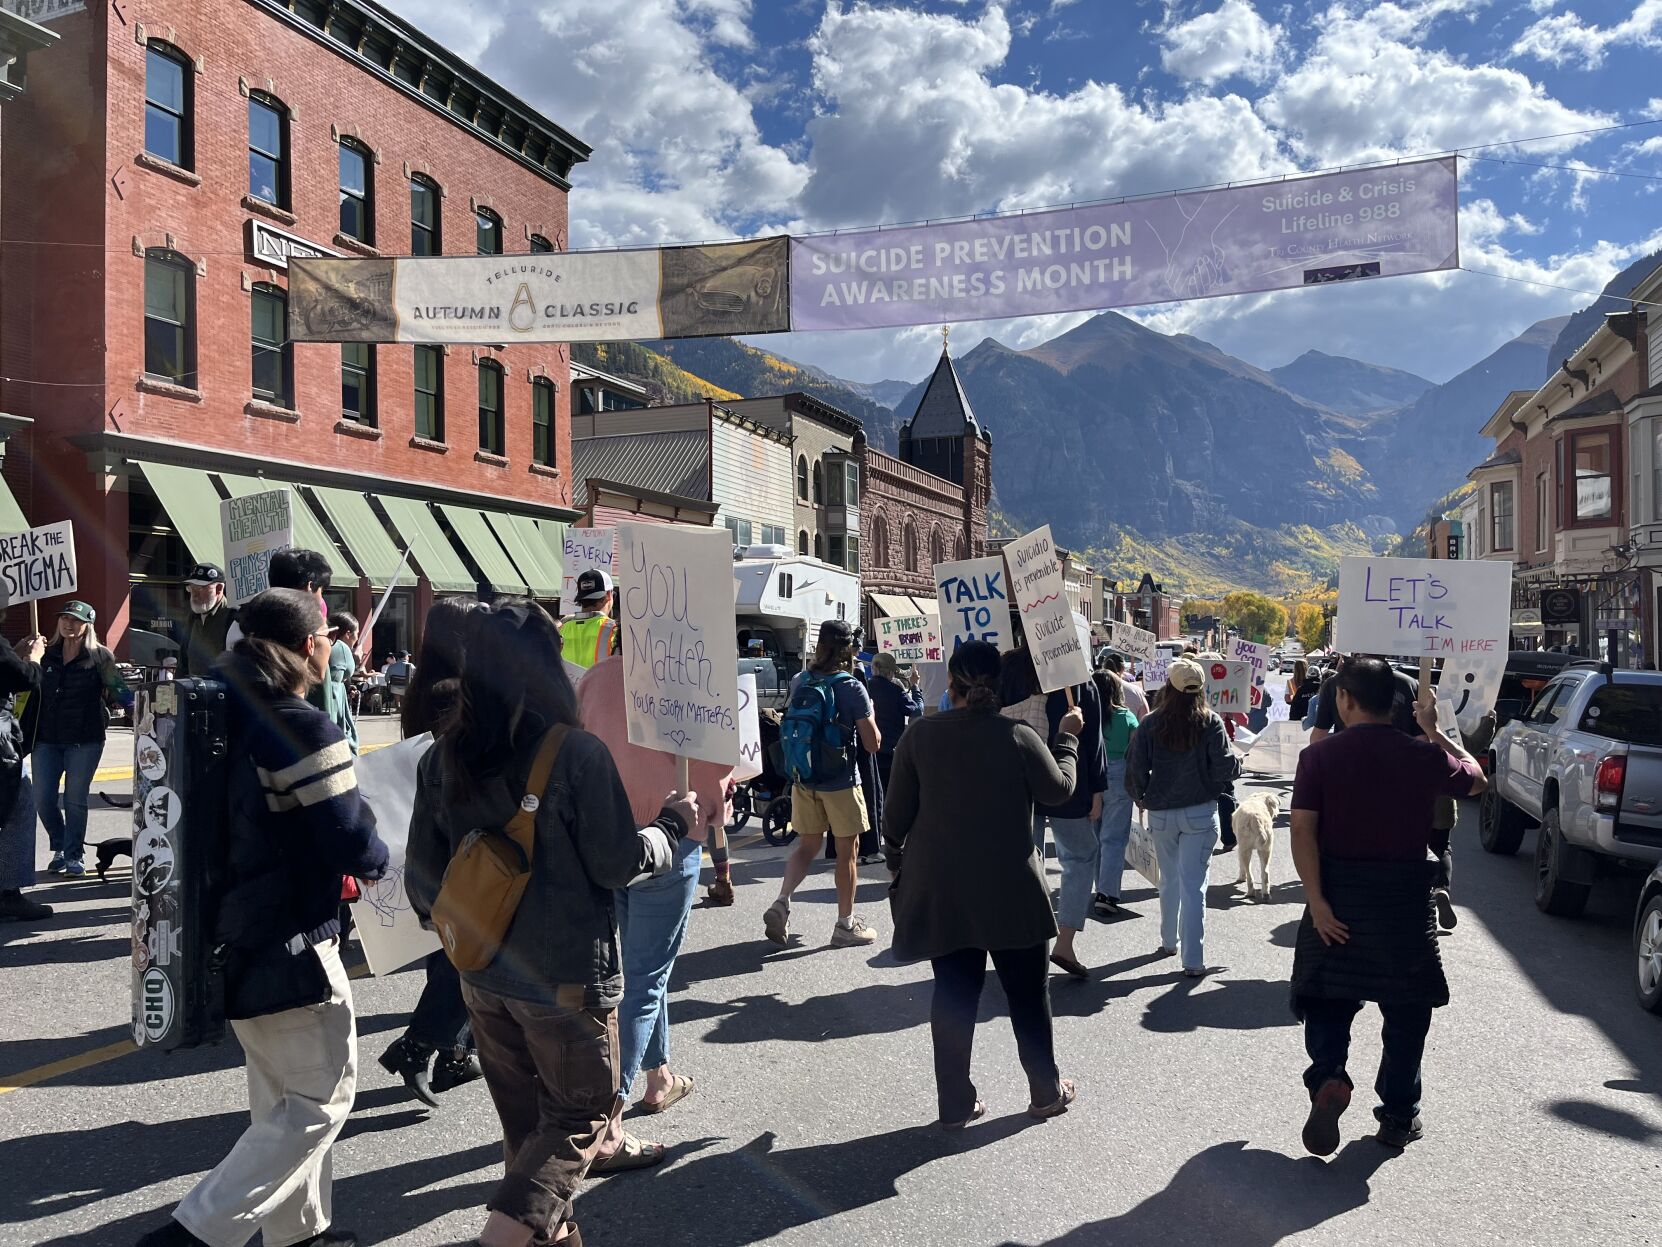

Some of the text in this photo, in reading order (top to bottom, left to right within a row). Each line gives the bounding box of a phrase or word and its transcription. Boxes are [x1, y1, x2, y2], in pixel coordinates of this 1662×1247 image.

[1262, 178, 1416, 212] Suicide & Crisis
[1281, 201, 1401, 233] Lifeline 988
[811, 220, 1132, 276] SUICIDE PREVENTION
[486, 264, 562, 285] TELLURIDE
[820, 255, 1132, 308] AWARENESS MONTH
[413, 306, 500, 320] AUTUMN
[544, 301, 639, 318] CLASSIC
[228, 490, 290, 520] MENTAL
[43, 531, 64, 546] THE
[229, 508, 289, 542] HEALTH
[230, 544, 290, 578] PHYSI
[565, 540, 613, 565] BEVERLY
[2, 552, 75, 597] STIGMA
[939, 571, 1005, 604] TALK
[1365, 566, 1448, 604] LET'S
[881, 616, 928, 635] IF THERE'S
[957, 606, 991, 632] TO
[914, 647, 924, 660] IS
[1115, 637, 1150, 659] Loved
[1235, 640, 1257, 656] you
[1424, 635, 1499, 653] I'M HERE
[630, 690, 657, 720] YOUR
[659, 698, 686, 723] STORY
[145, 978, 165, 1029] CHQ
